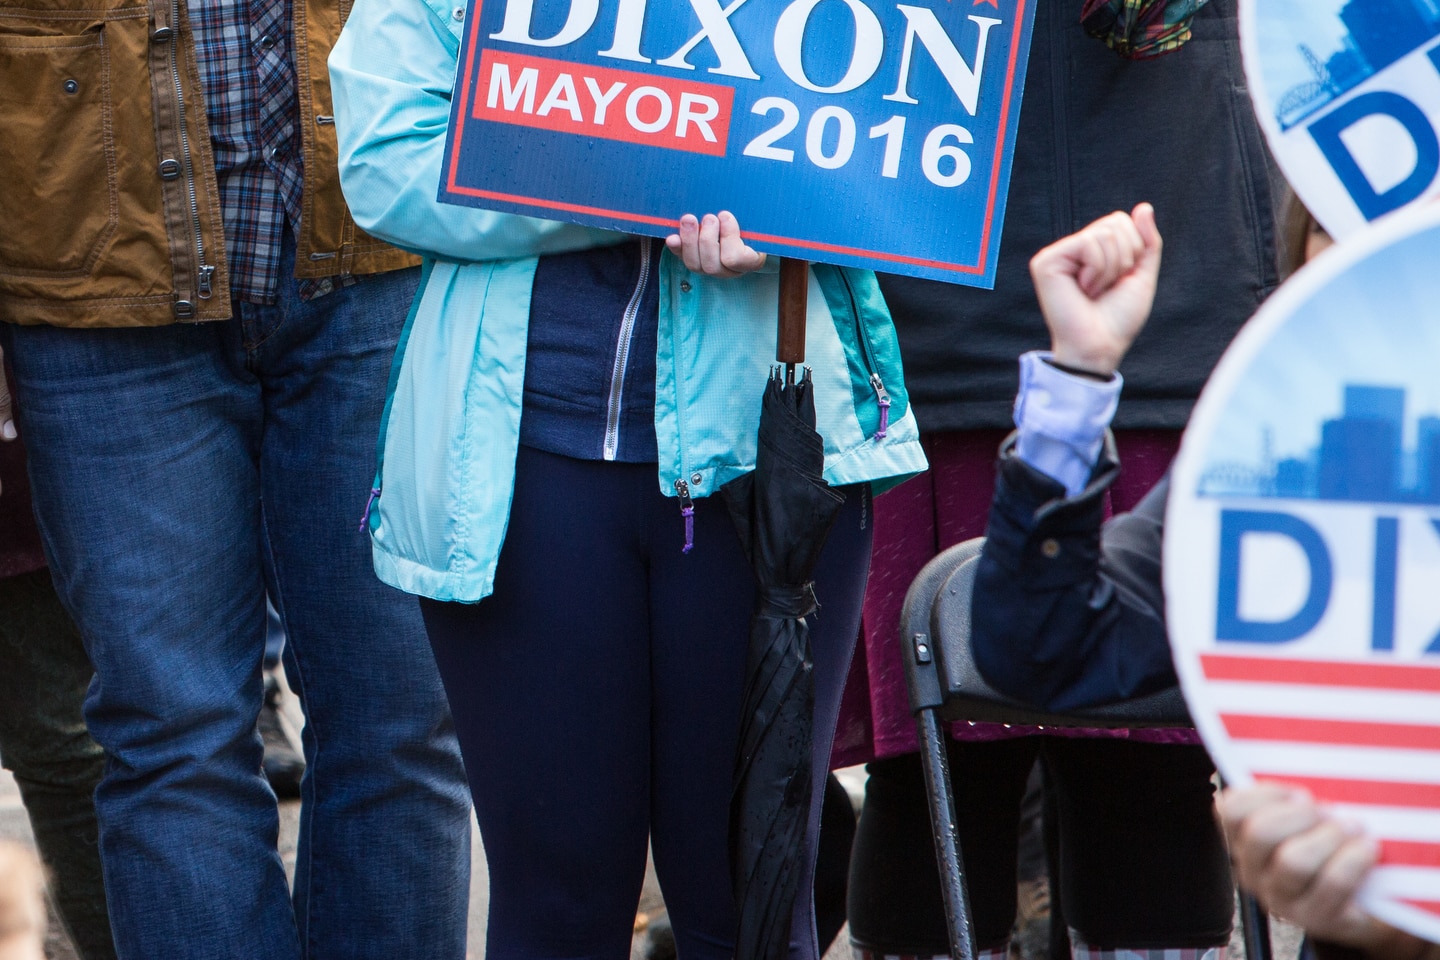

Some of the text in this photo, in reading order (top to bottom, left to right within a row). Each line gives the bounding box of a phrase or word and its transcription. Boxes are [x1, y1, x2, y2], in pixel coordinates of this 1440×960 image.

[486, 63, 975, 188] MAYOR 2016
[1216, 509, 1440, 653] DI
